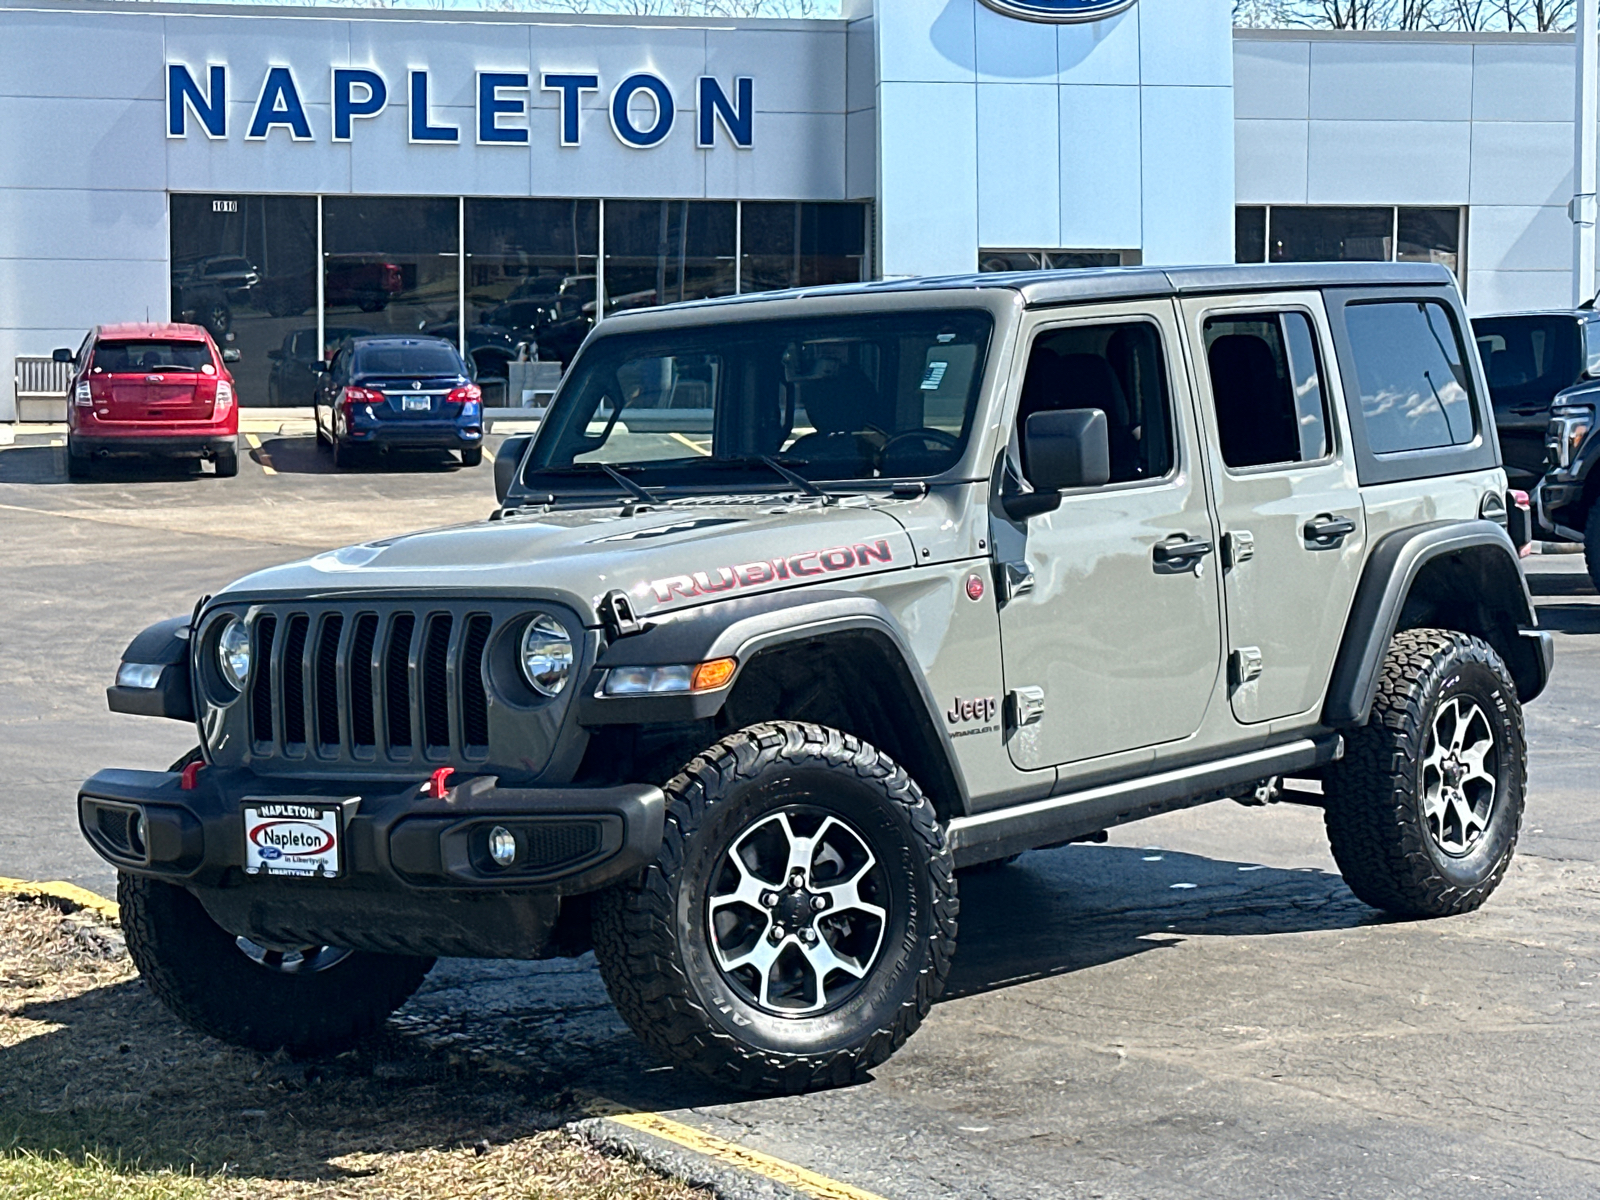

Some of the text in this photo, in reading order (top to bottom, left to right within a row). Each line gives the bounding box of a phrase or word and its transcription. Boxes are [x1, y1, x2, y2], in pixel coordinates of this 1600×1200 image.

[165, 62, 754, 149] NAPLETON
[214, 201, 236, 212] 1010
[651, 539, 893, 602] RUBICON
[947, 696, 997, 724] Jeep
[261, 805, 315, 819] NAPLETON
[264, 828, 321, 849] Napleton
[262, 848, 278, 858] Ford
[292, 856, 329, 866] Libertyville
